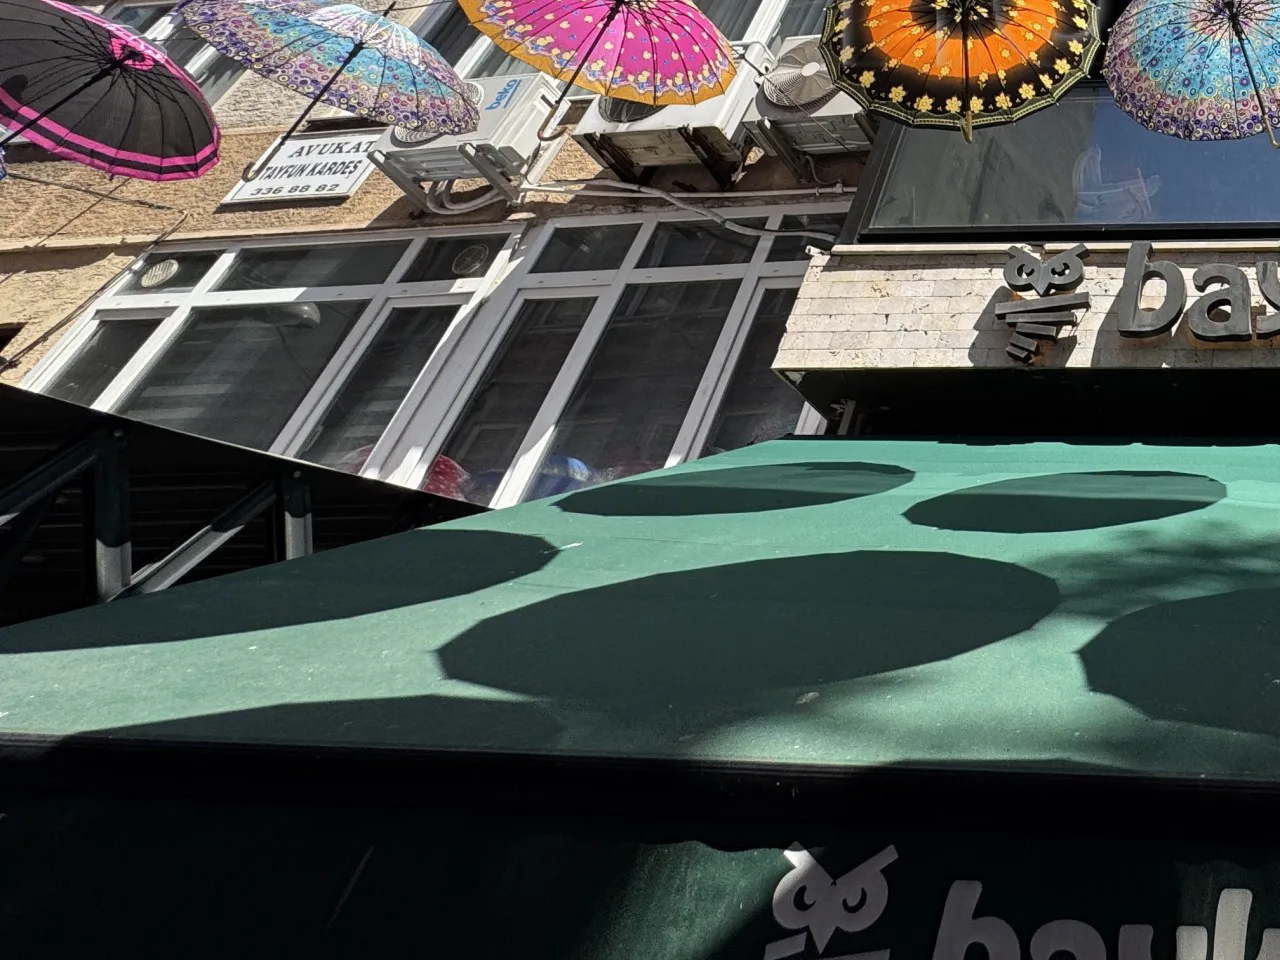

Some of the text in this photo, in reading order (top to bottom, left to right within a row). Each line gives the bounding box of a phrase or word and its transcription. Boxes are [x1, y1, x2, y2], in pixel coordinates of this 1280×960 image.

[485, 79, 518, 111] beko
[288, 141, 377, 158] AVUKAT
[259, 160, 363, 181] TAYFUN KARDEŞ
[250, 183, 340, 196] 336 88 82
